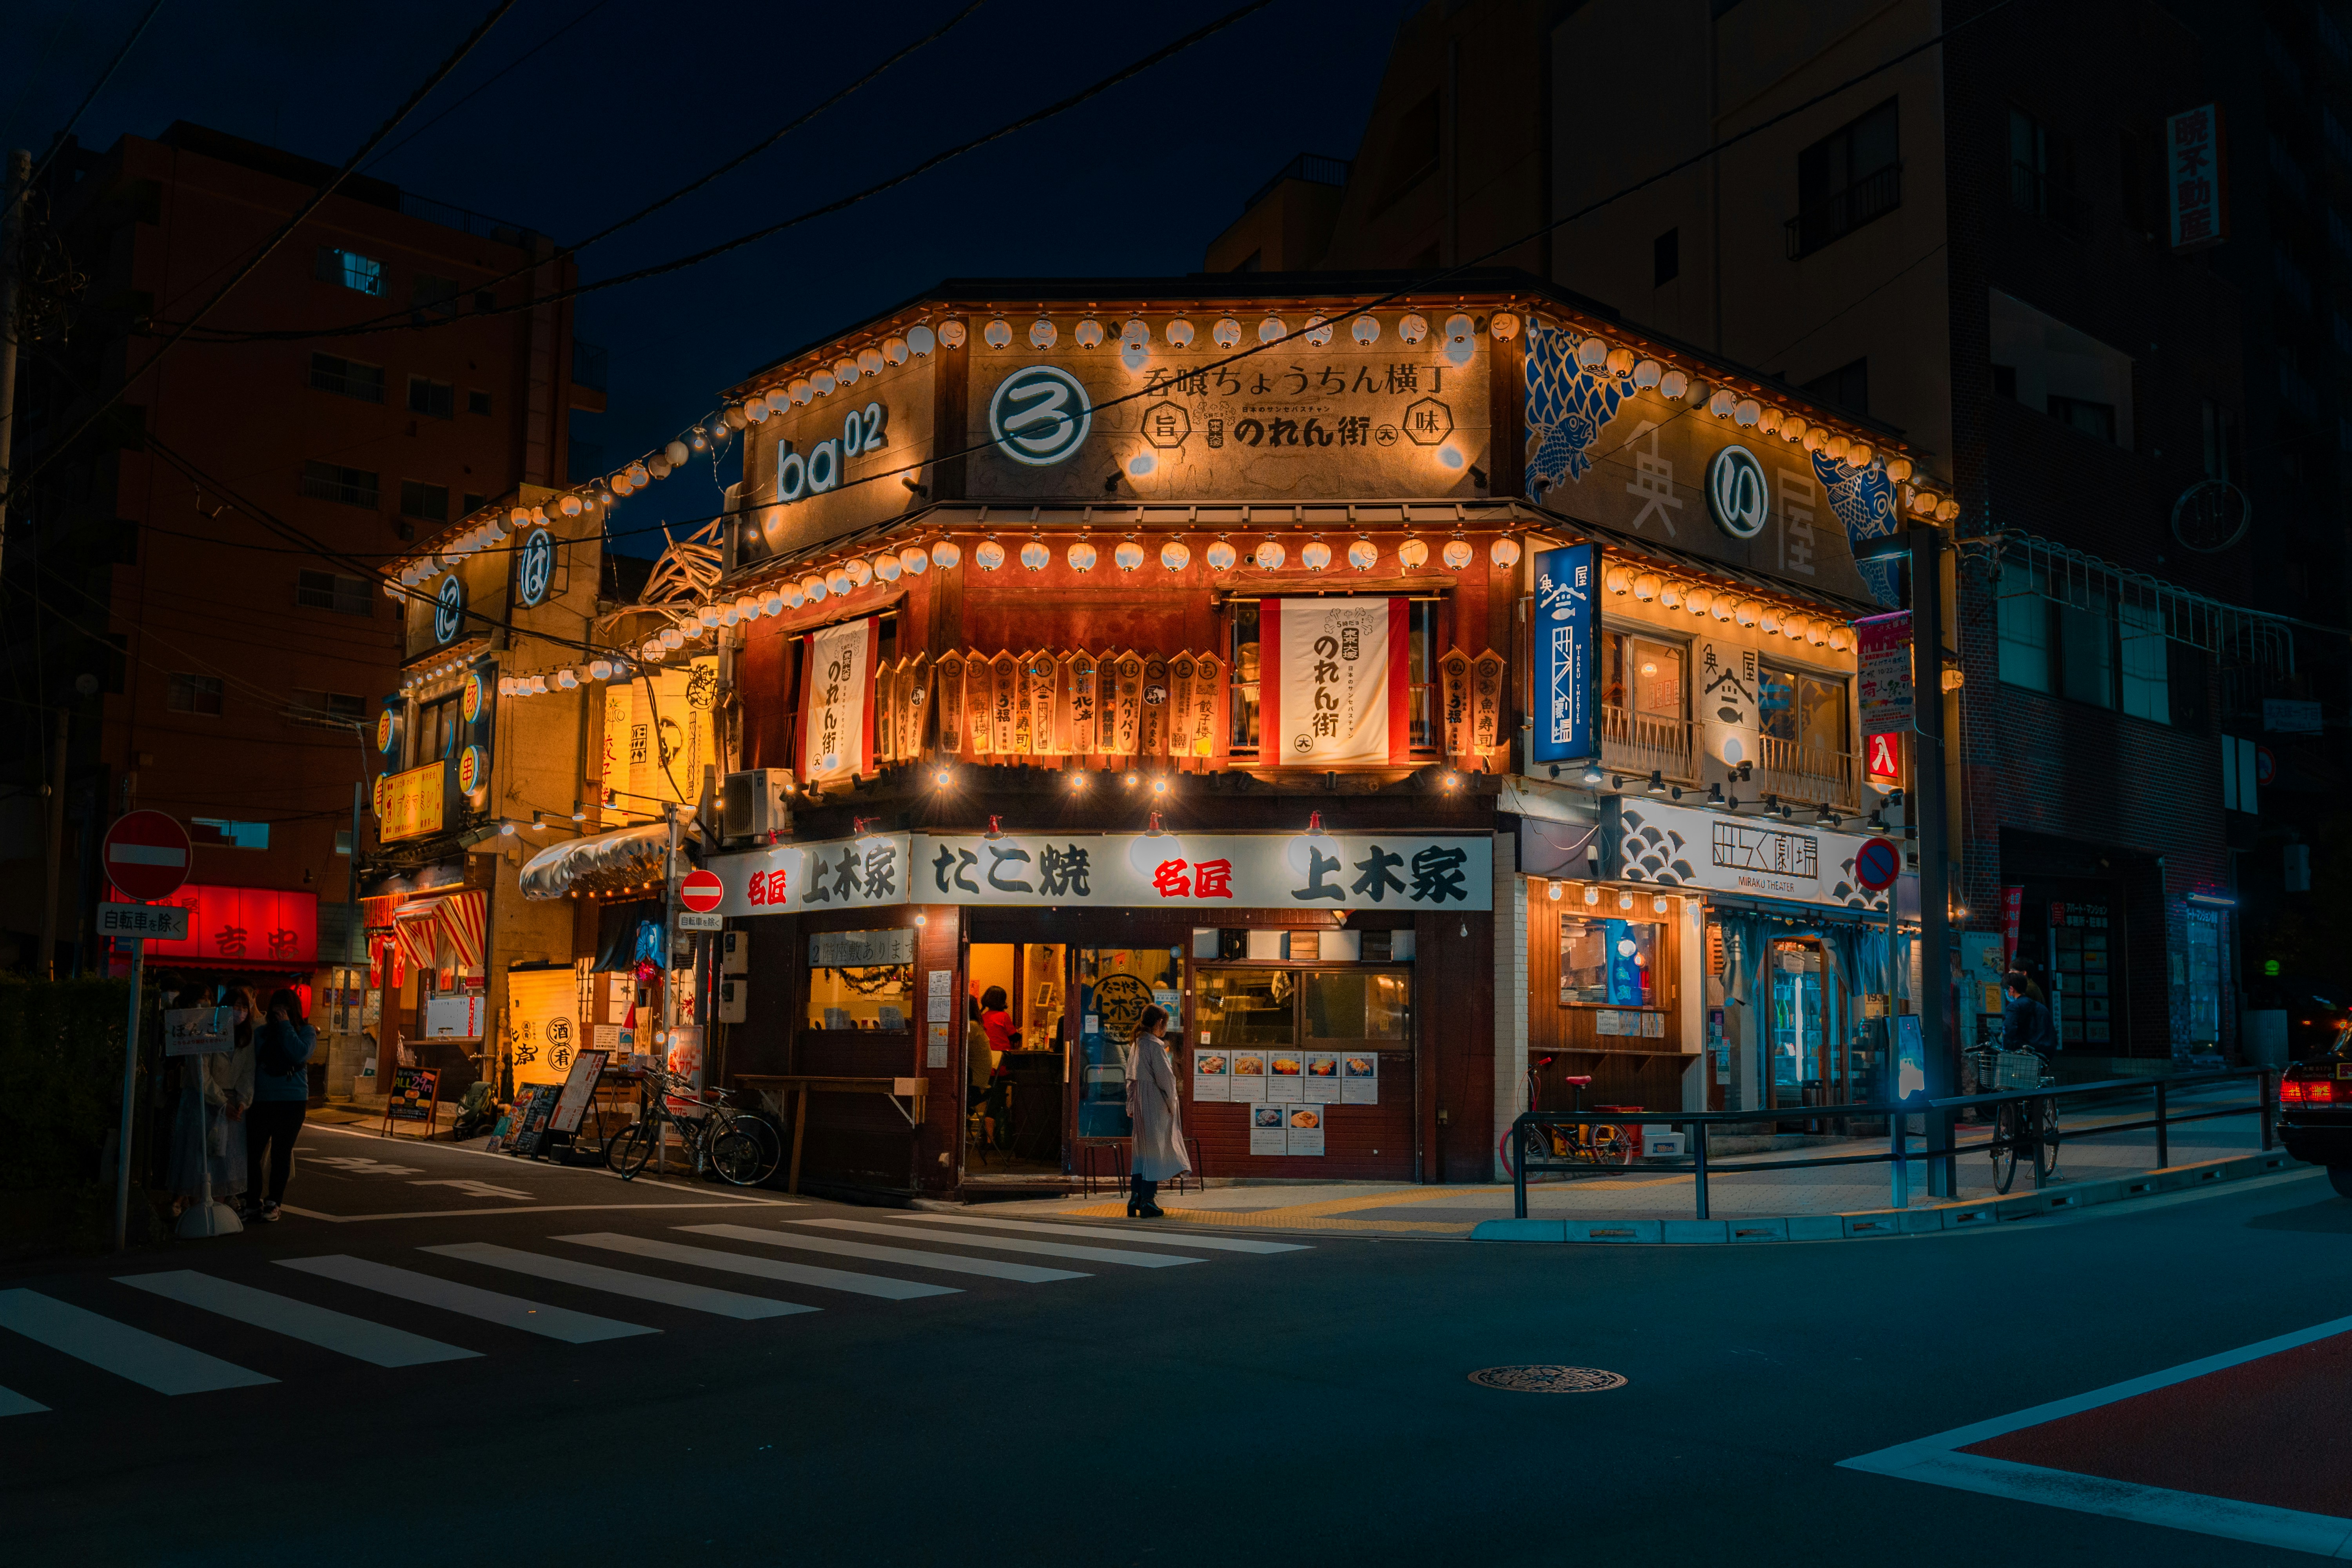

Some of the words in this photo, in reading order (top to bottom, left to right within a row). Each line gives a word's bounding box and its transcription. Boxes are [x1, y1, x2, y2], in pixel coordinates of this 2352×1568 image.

[1143, 364, 1453, 397] 呑喰ちょうちん横丁
[1156, 416, 1175, 436] 旨
[1234, 416, 1370, 447] のれん街
[1416, 411, 1439, 434] 味
[1778, 467, 1815, 575] 屋
[1575, 566, 1587, 587] 屋
[1343, 630, 1359, 658] 東京大塚
[842, 652, 851, 680] 東京大塚
[1743, 651, 1755, 682] 屋
[1313, 635, 1339, 738] のれん街
[822, 661, 841, 756] のれん街
[1016, 698, 1031, 747] 魚寿司
[1121, 698, 1133, 740] パリパリ
[1194, 700, 1214, 740] 餃子楼
[1478, 697, 1495, 748] 魚寿司
[802, 844, 897, 903] 上木家
[932, 843, 1091, 897] たこ焼
[1152, 858, 1233, 898] 名匠
[1291, 845, 1468, 903] 上木家
[1739, 876, 1765, 890] MIRAKU
[1767, 878, 1795, 892] THEATER
[747, 869, 787, 906] 名匠
[104, 910, 181, 933] 自転車を除く
[681, 916, 720, 927] 自転車を除く
[2051, 901, 2065, 926] 貸
[2066, 903, 2108, 915] アパート・マンション
[813, 938, 914, 963] 2階座敷あります
[394, 1077, 411, 1088] ALL
